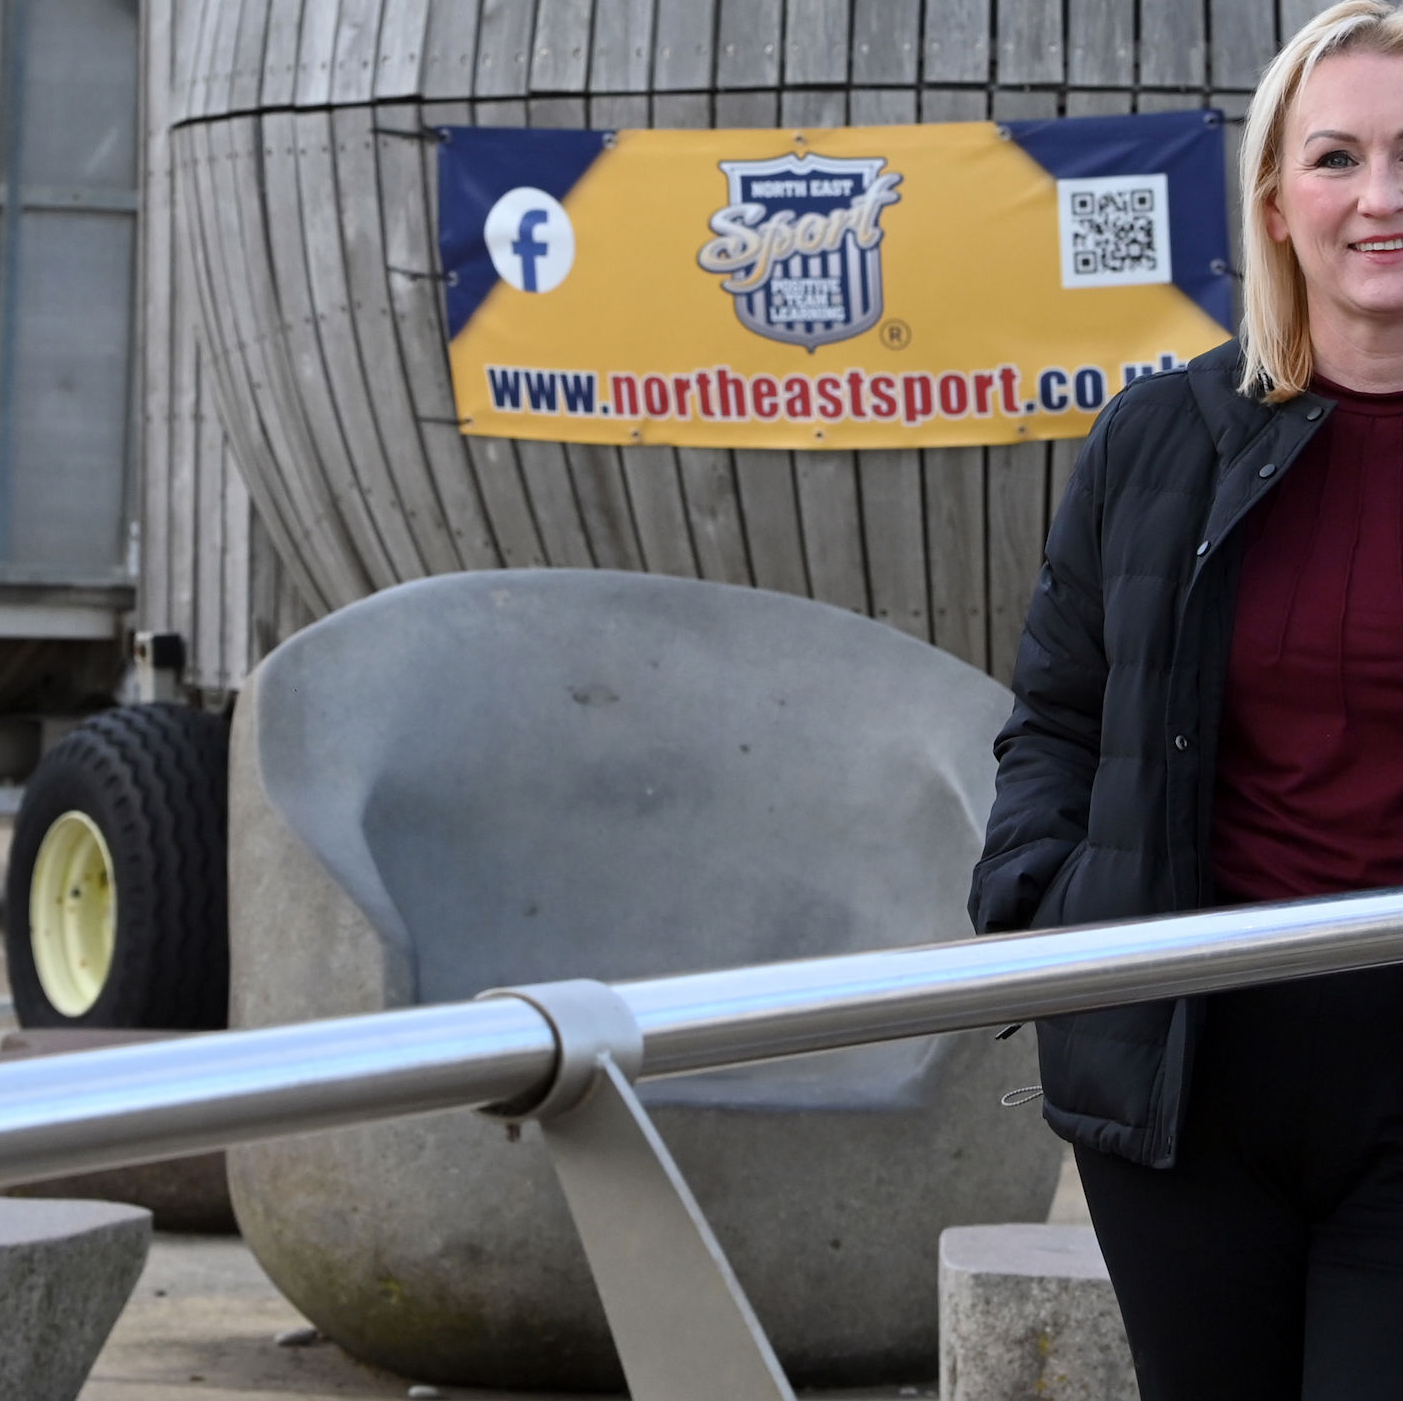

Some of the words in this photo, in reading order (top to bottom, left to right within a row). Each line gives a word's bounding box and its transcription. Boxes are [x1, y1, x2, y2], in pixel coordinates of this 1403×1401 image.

[750, 180, 808, 199] NORTH
[809, 178, 854, 197] EAST
[696, 172, 904, 294] Sport
[485, 355, 1188, 423] www.northeastsport.co
